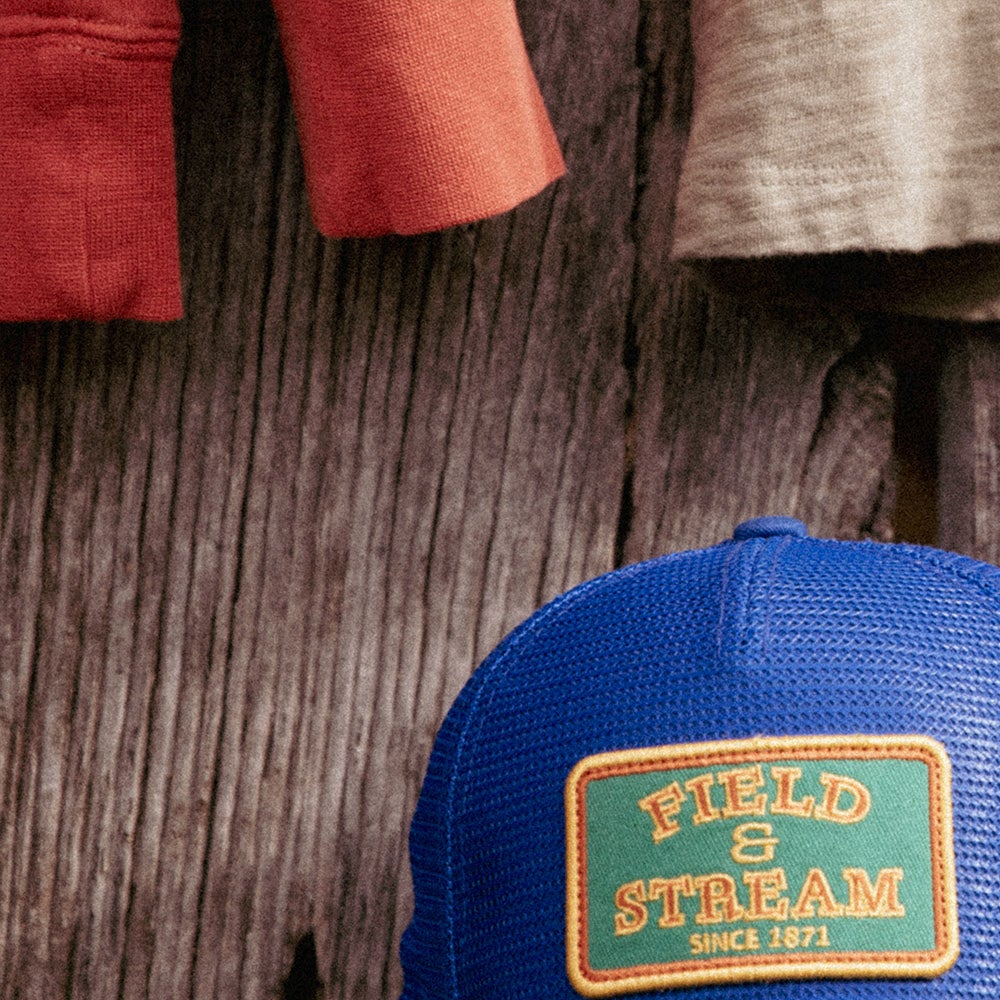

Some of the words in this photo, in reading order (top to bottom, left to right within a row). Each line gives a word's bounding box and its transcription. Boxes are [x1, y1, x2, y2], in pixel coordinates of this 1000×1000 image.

[638, 764, 872, 845] FIELD
[730, 821, 779, 865] &
[613, 866, 906, 937] STREAM
[689, 927, 760, 955] SINCE
[768, 924, 830, 950] 1871
